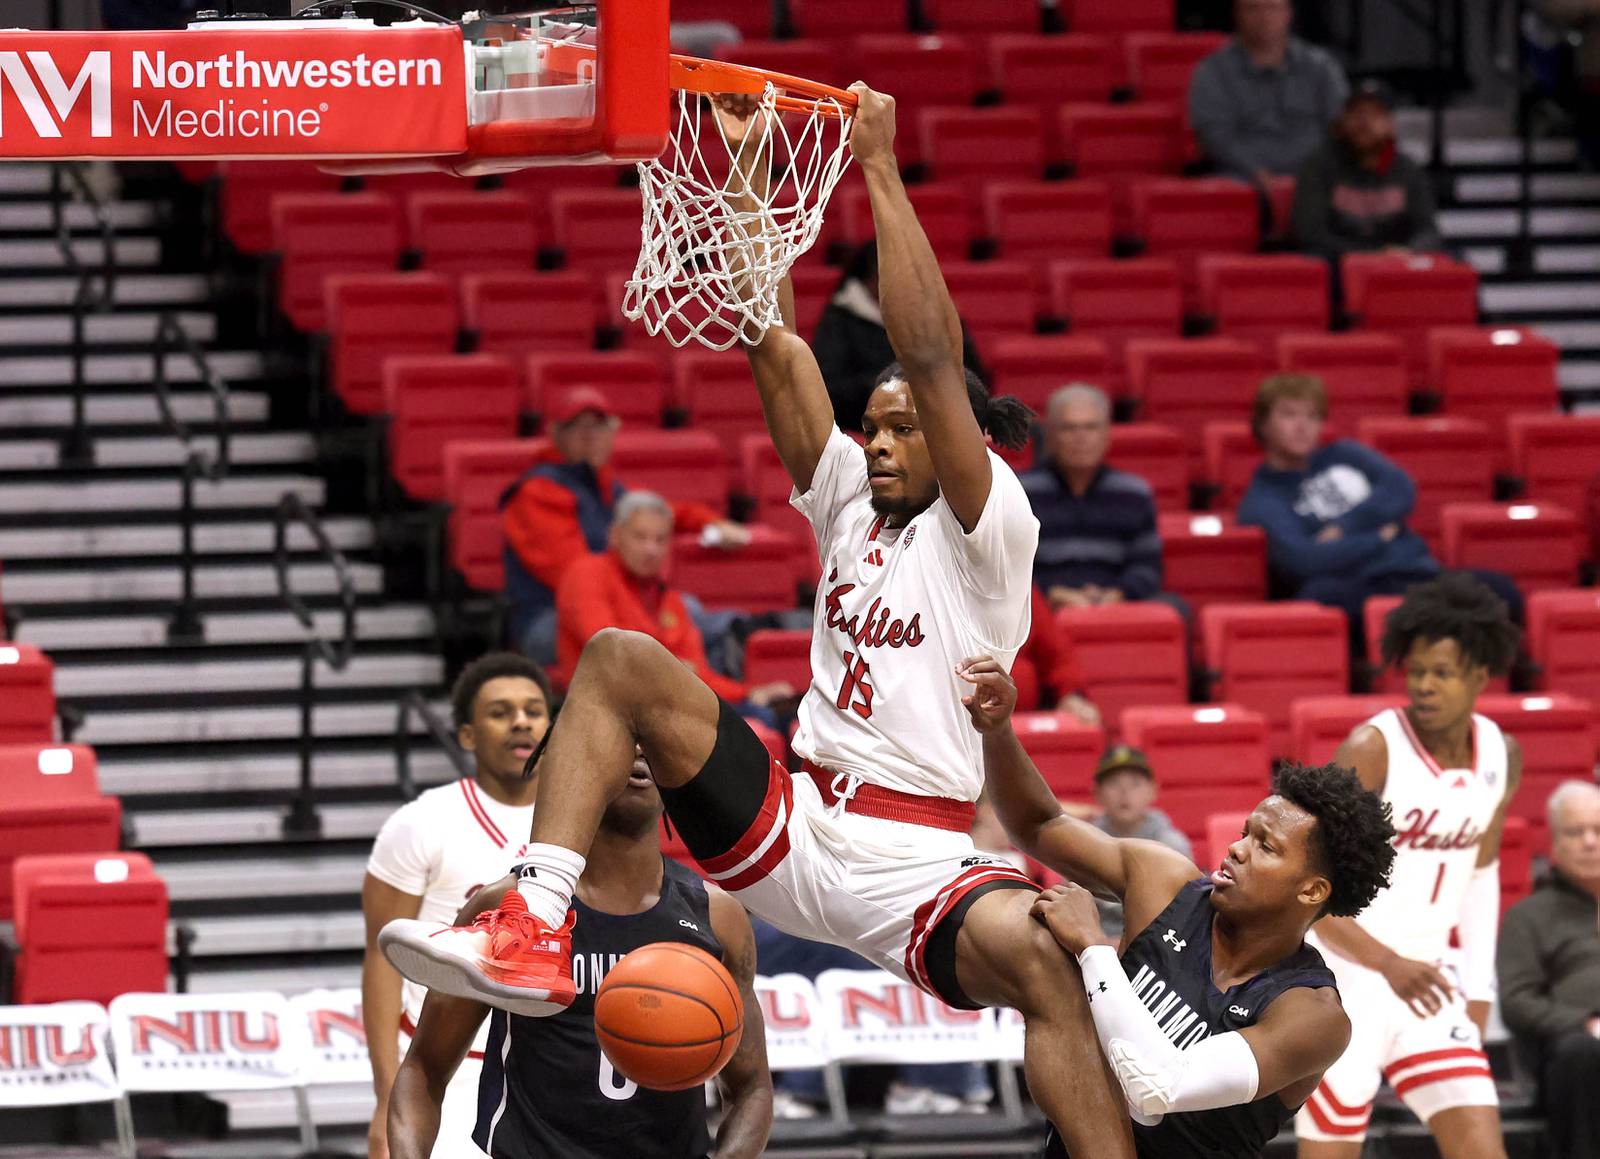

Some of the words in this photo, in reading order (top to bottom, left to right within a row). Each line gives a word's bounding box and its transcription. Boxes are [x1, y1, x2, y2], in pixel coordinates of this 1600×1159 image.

[132, 50, 442, 89] Northwestern
[837, 650, 875, 720] 15
[1430, 862, 1446, 904] 1
[1130, 964, 1212, 1051] MONMO
[129, 1010, 281, 1055] NIU
